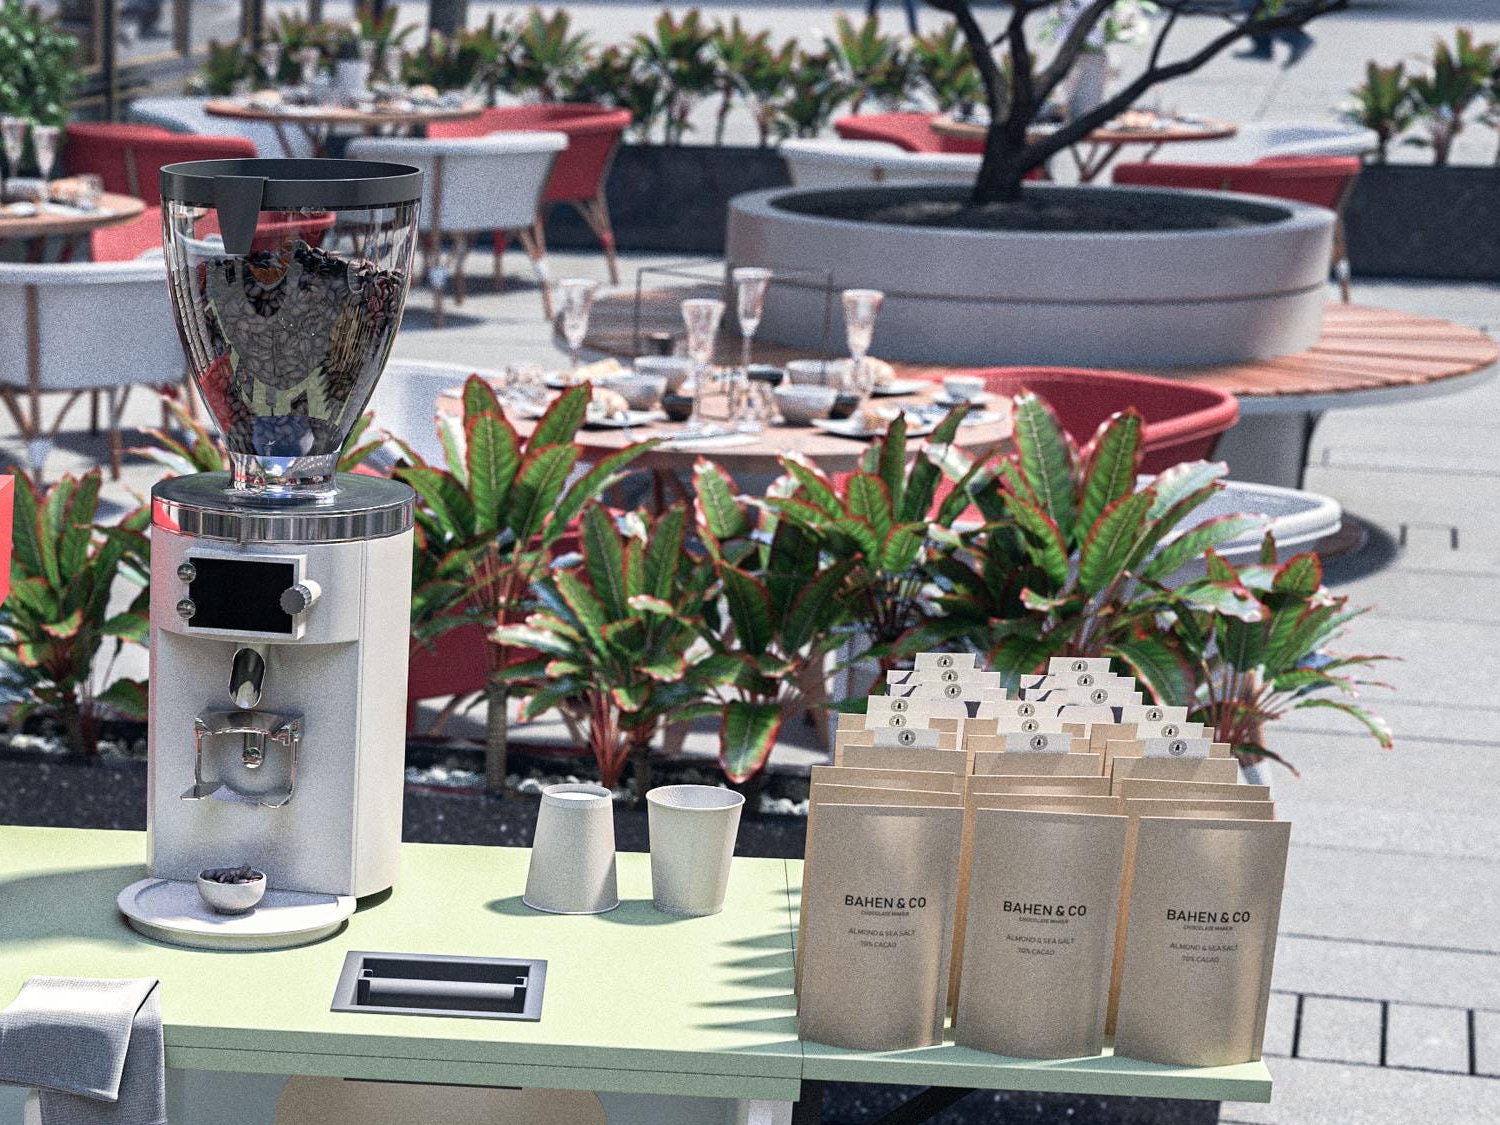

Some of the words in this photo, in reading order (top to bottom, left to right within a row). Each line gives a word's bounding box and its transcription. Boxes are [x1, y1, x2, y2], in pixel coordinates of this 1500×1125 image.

[845, 895, 894, 908] BAHEN
[896, 898, 905, 908] &
[909, 897, 927, 908] CO
[1003, 901, 1052, 915] BAHEN
[1056, 905, 1065, 916] &
[1068, 905, 1087, 916] CO
[1167, 909, 1217, 923] BAHEN
[1220, 912, 1229, 923] &
[1232, 911, 1250, 923] CO
[848, 928, 878, 936] ALMOND
[1006, 934, 1036, 943] ALMOND
[1170, 943, 1200, 951] ALMOND
